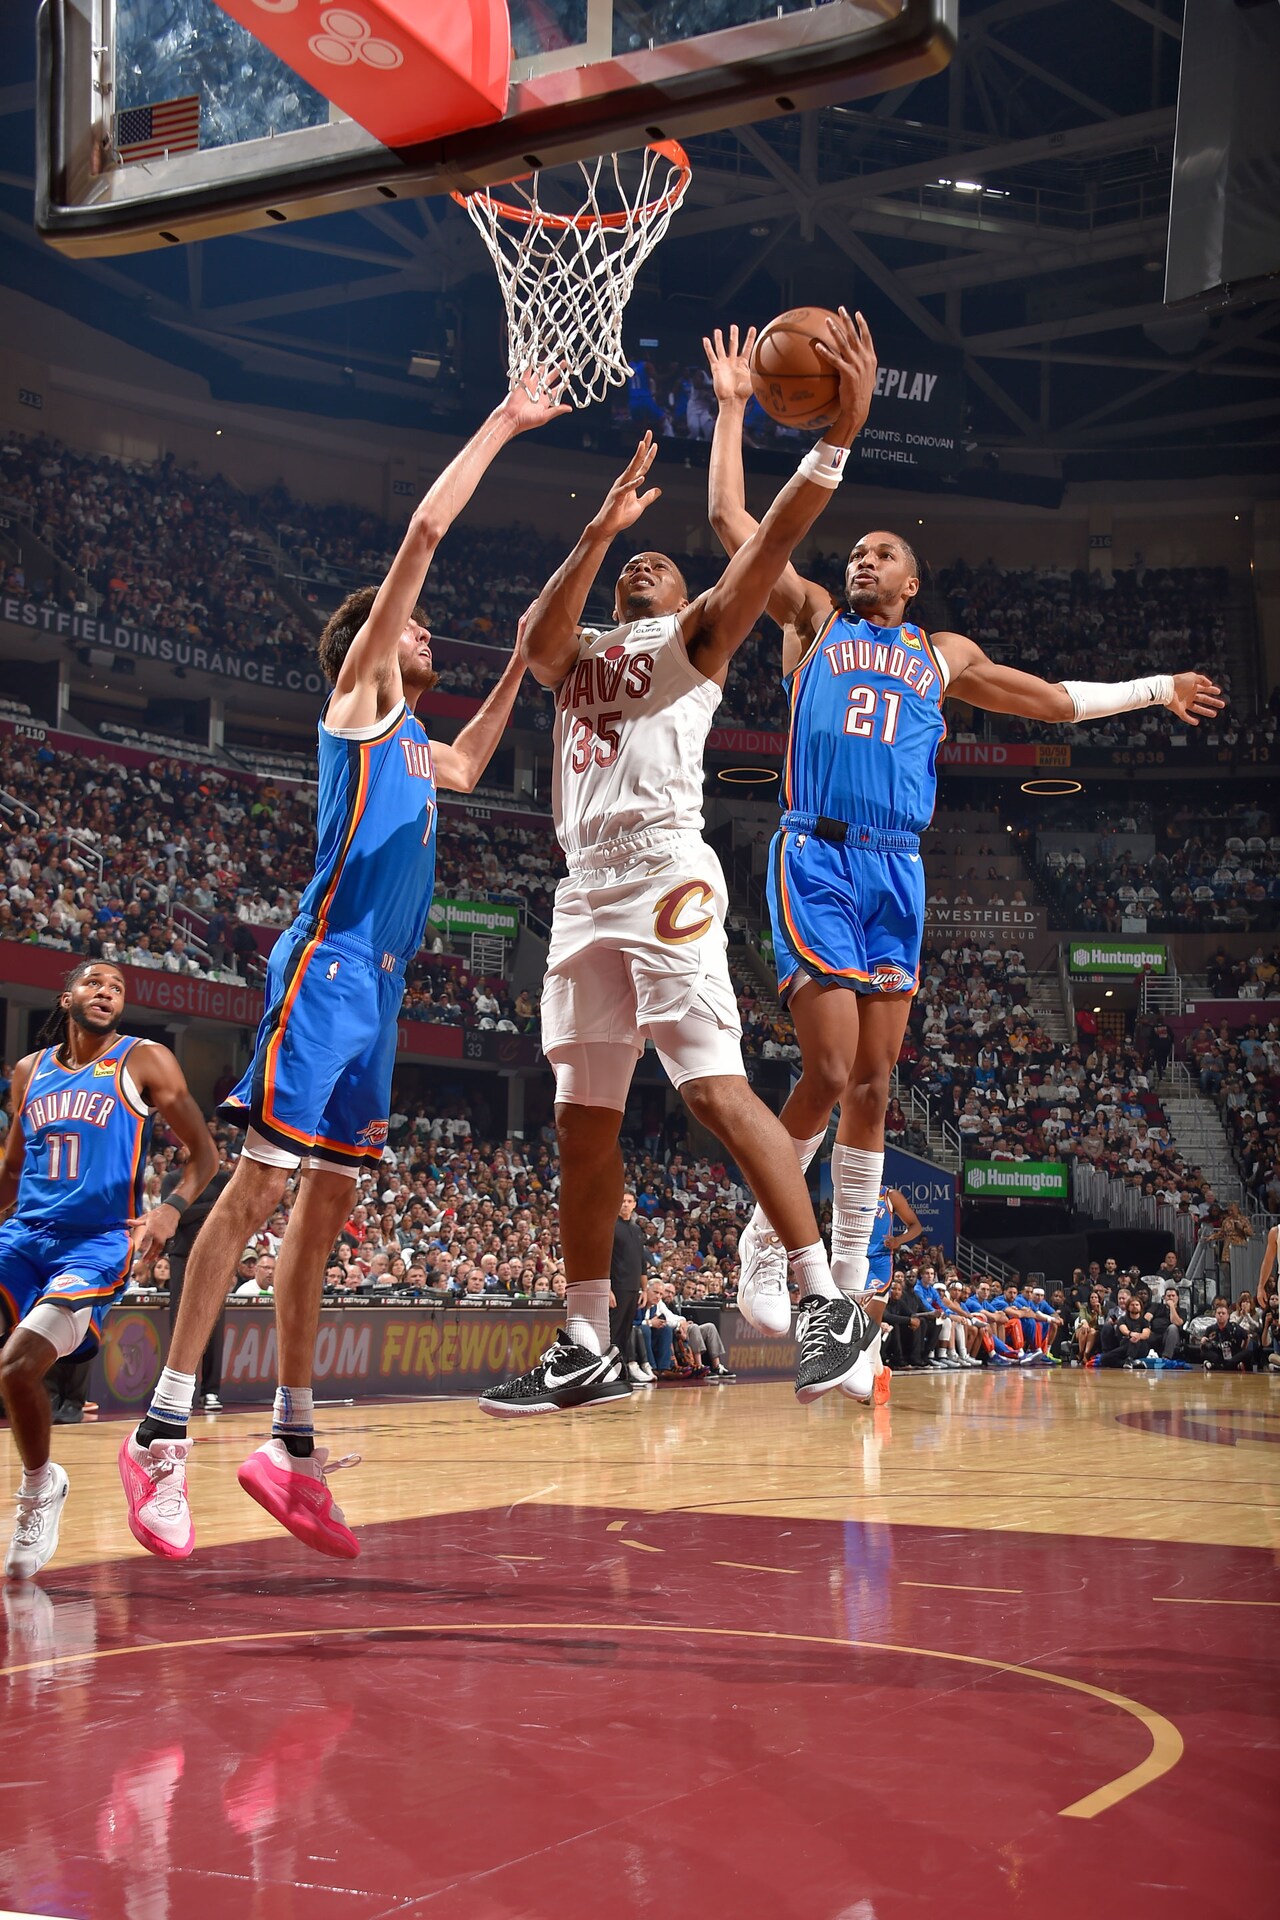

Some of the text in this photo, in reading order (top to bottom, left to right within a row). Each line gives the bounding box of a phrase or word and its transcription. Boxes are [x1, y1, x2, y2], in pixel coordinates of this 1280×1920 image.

[873, 367, 938, 402] EPLAY
[864, 428, 902, 443] POINTS.
[906, 434, 954, 449] DONOVAN
[861, 447, 918, 465] MITCHELL.
[0, 597, 331, 694] ESTFIELDINSURANCE.CO
[561, 653, 654, 712] AVS
[824, 639, 936, 701] THUNDER
[843, 684, 903, 746] 21
[571, 711, 623, 775] 35
[706, 730, 783, 753] OVIDIN
[943, 745, 1008, 763] MIND
[422, 796, 436, 848] 7
[446, 905, 516, 930] Huntington
[936, 910, 1035, 923] WESTFIELD
[927, 930, 1035, 940] HAMPIONS CLUB
[1091, 949, 1162, 968] Huntington
[467, 1043, 483, 1058] 33
[25, 1089, 117, 1134] THUNDER
[46, 1132, 80, 1180] 11
[987, 1169, 1062, 1191] Huntington
